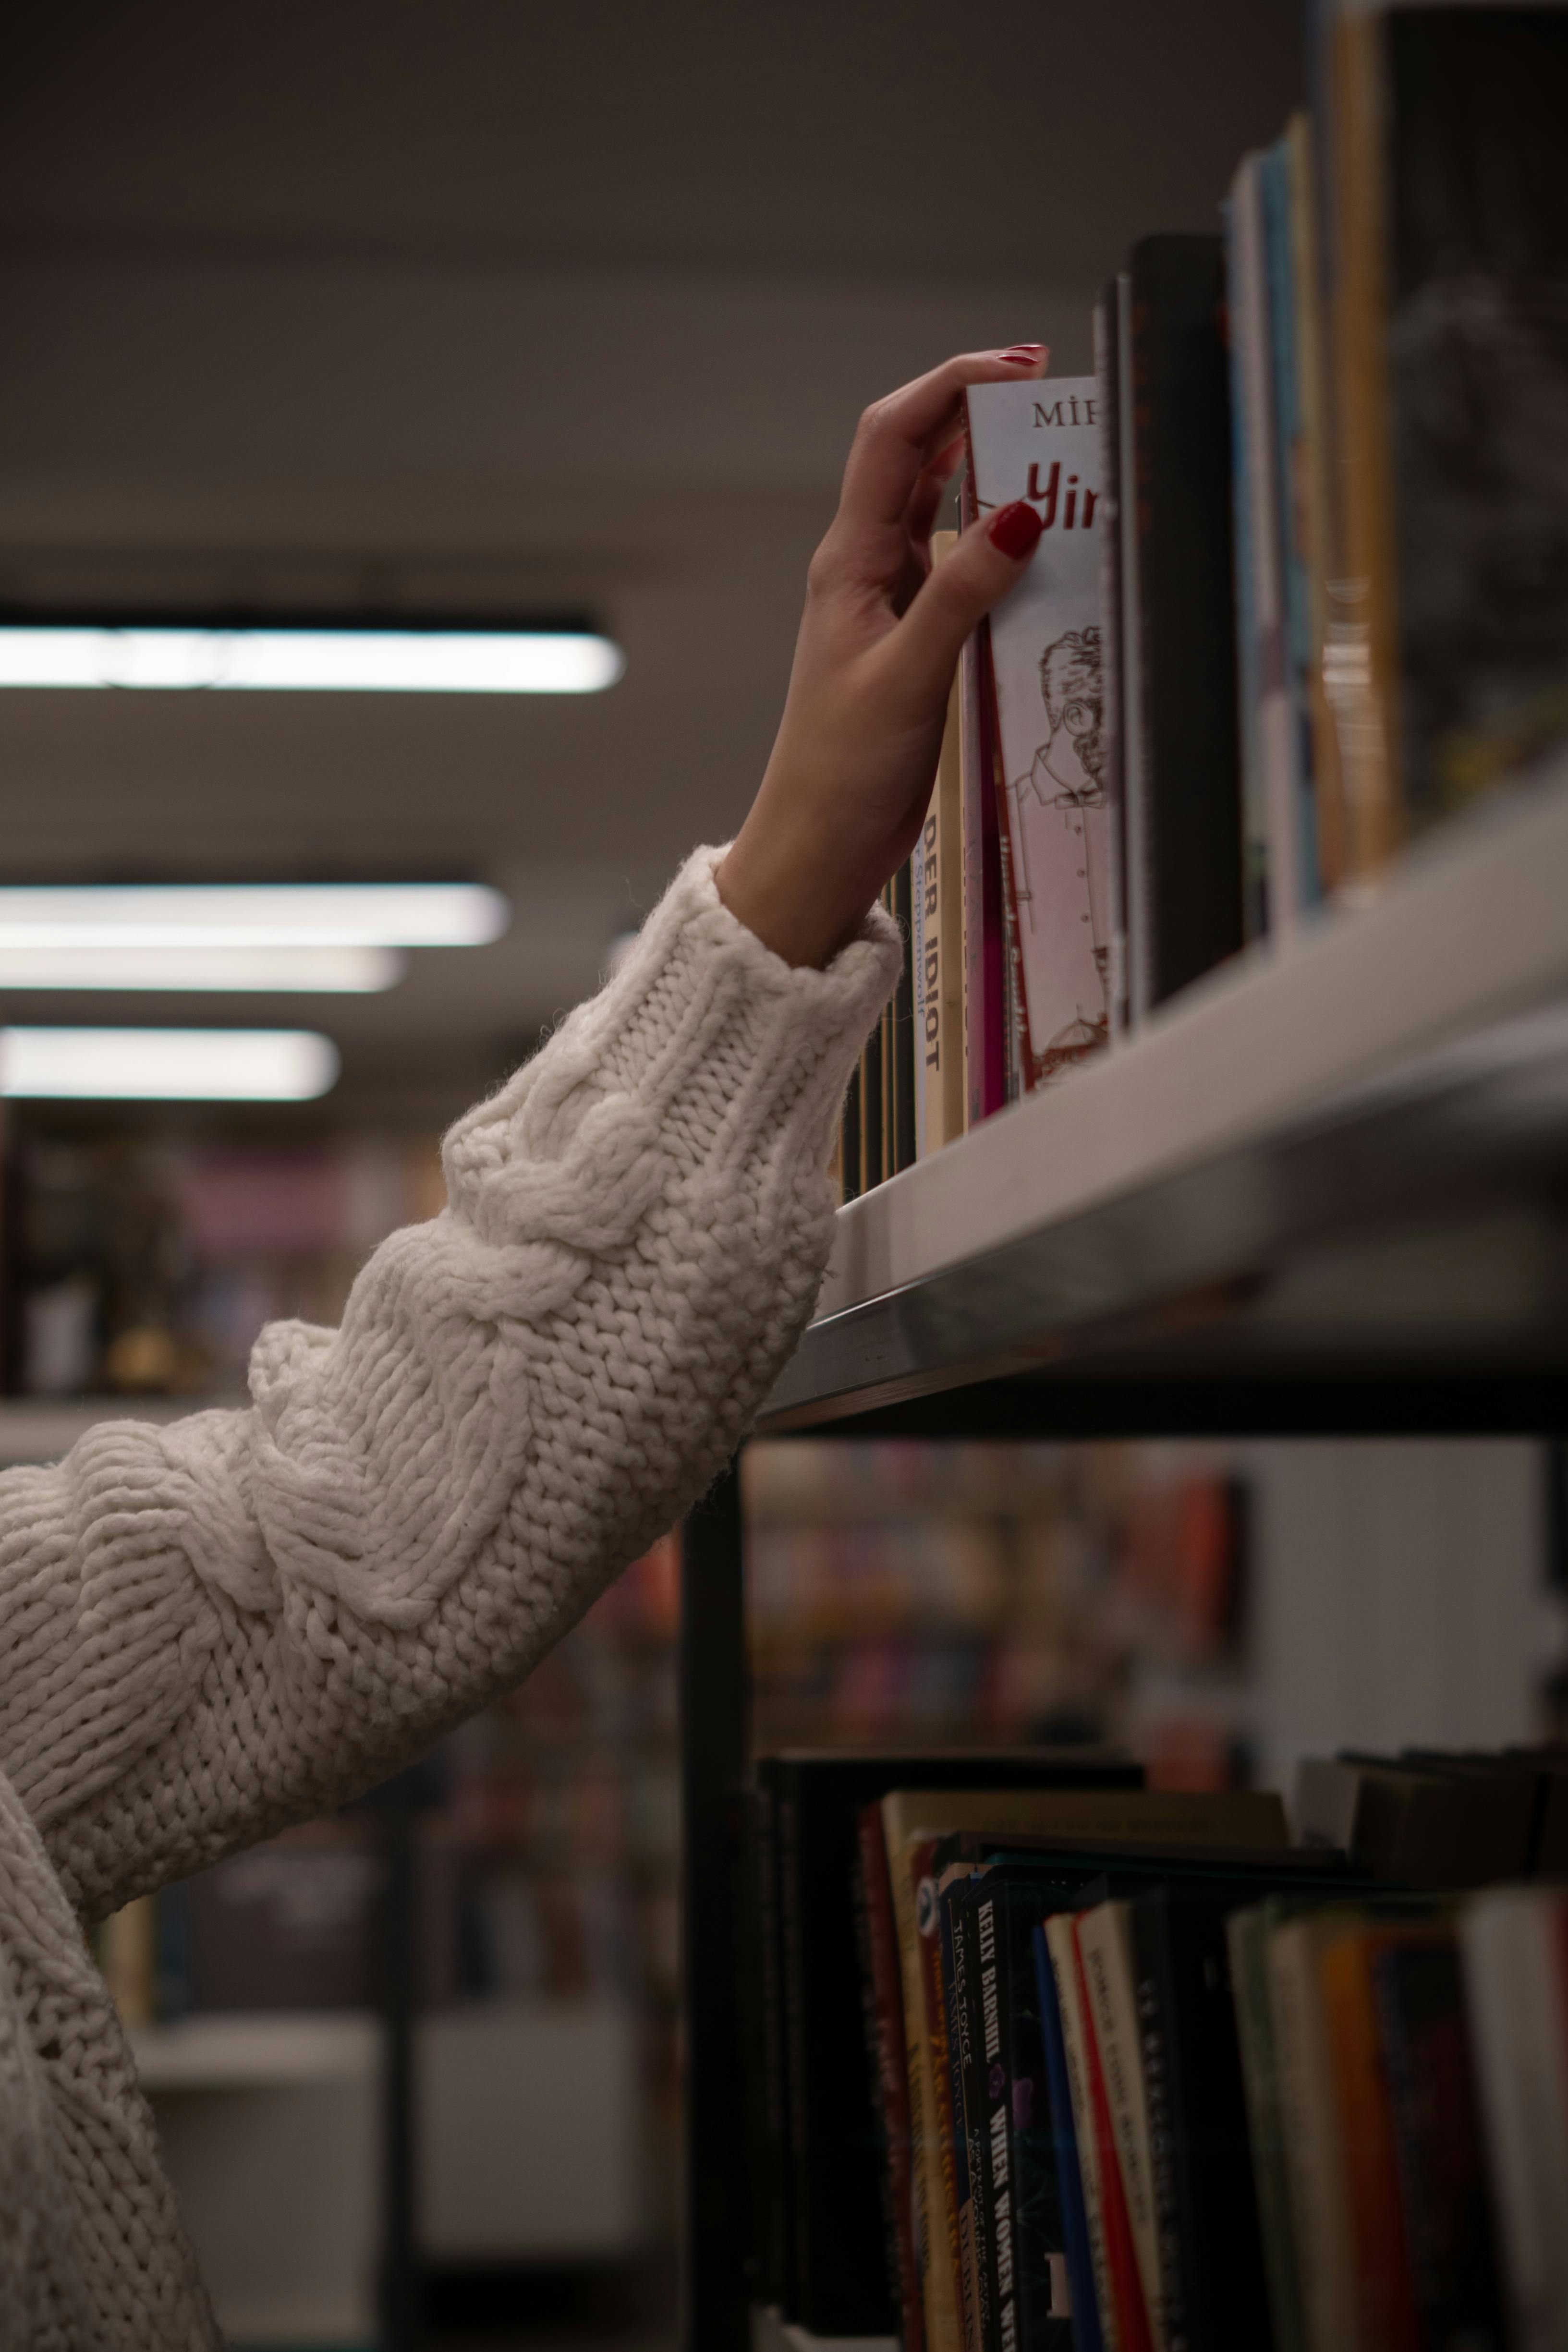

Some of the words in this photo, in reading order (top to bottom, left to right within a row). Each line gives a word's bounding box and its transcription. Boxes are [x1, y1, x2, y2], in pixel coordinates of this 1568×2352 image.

[924, 814, 937, 919] DER
[914, 865, 925, 1018] Steppenwolf
[924, 937, 939, 1071] IDIOT
[954, 1920, 965, 1993] JAMES
[978, 1900, 995, 1964] KELLY
[948, 1980, 958, 2051] JAMES
[959, 1997, 972, 2070] JOYCE
[968, 2138, 974, 2163] AS
[973, 2128, 980, 2137] A
[989, 2105, 1007, 2189] WHEN
[974, 2141, 984, 2206] PORTRAIT
[979, 2211, 985, 2229] OF
[994, 2191, 1011, 2297] WOMEN
[983, 2272, 991, 2323] ARTIST
